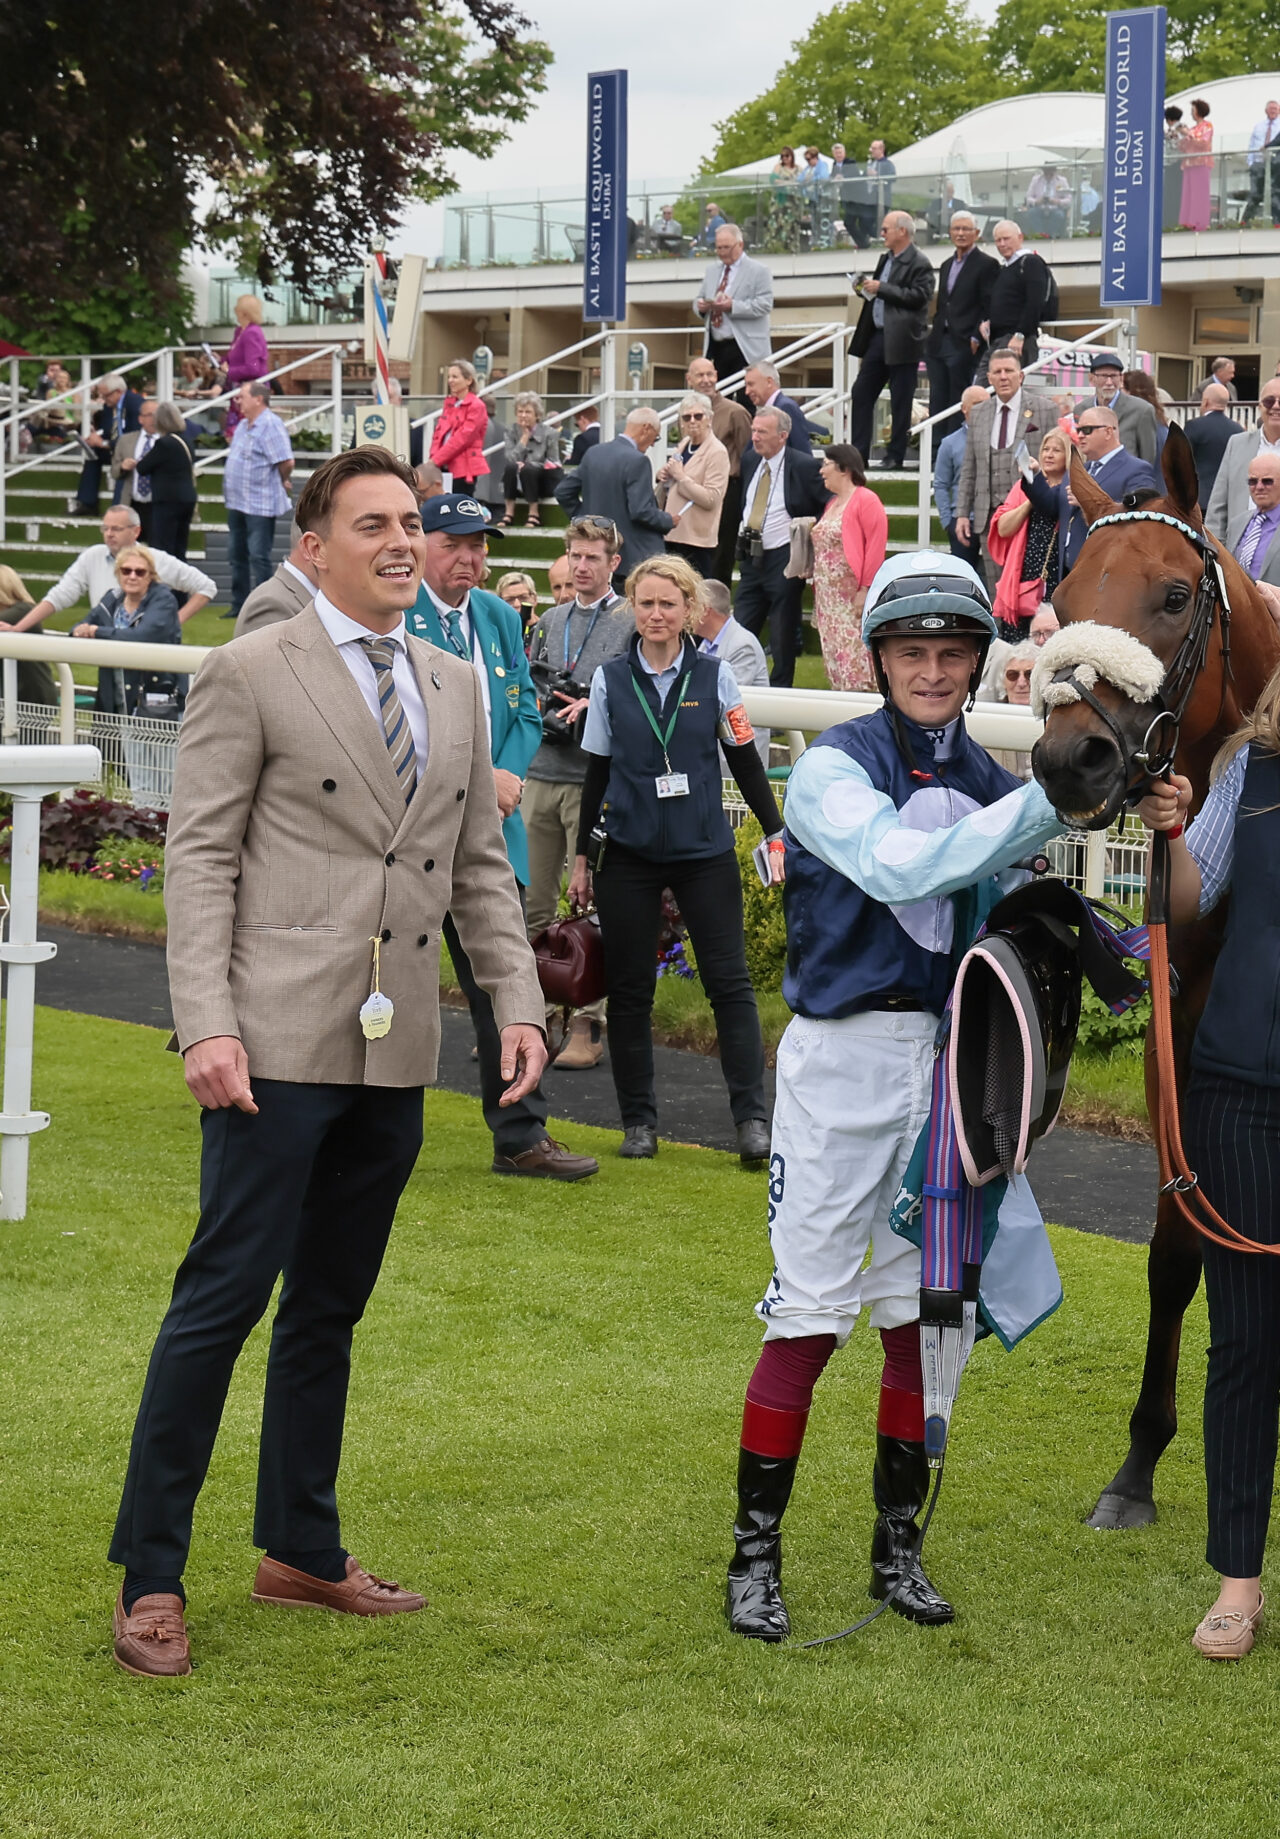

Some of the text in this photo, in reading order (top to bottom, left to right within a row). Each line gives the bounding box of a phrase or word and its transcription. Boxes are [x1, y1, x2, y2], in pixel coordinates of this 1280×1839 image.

[590, 83, 603, 308] AL BASTI EQUIWORLD
[602, 173, 612, 219] DUBAI
[1112, 25, 1132, 290] AL BASTI EQUIWORLD
[1132, 130, 1144, 185] DUBAI
